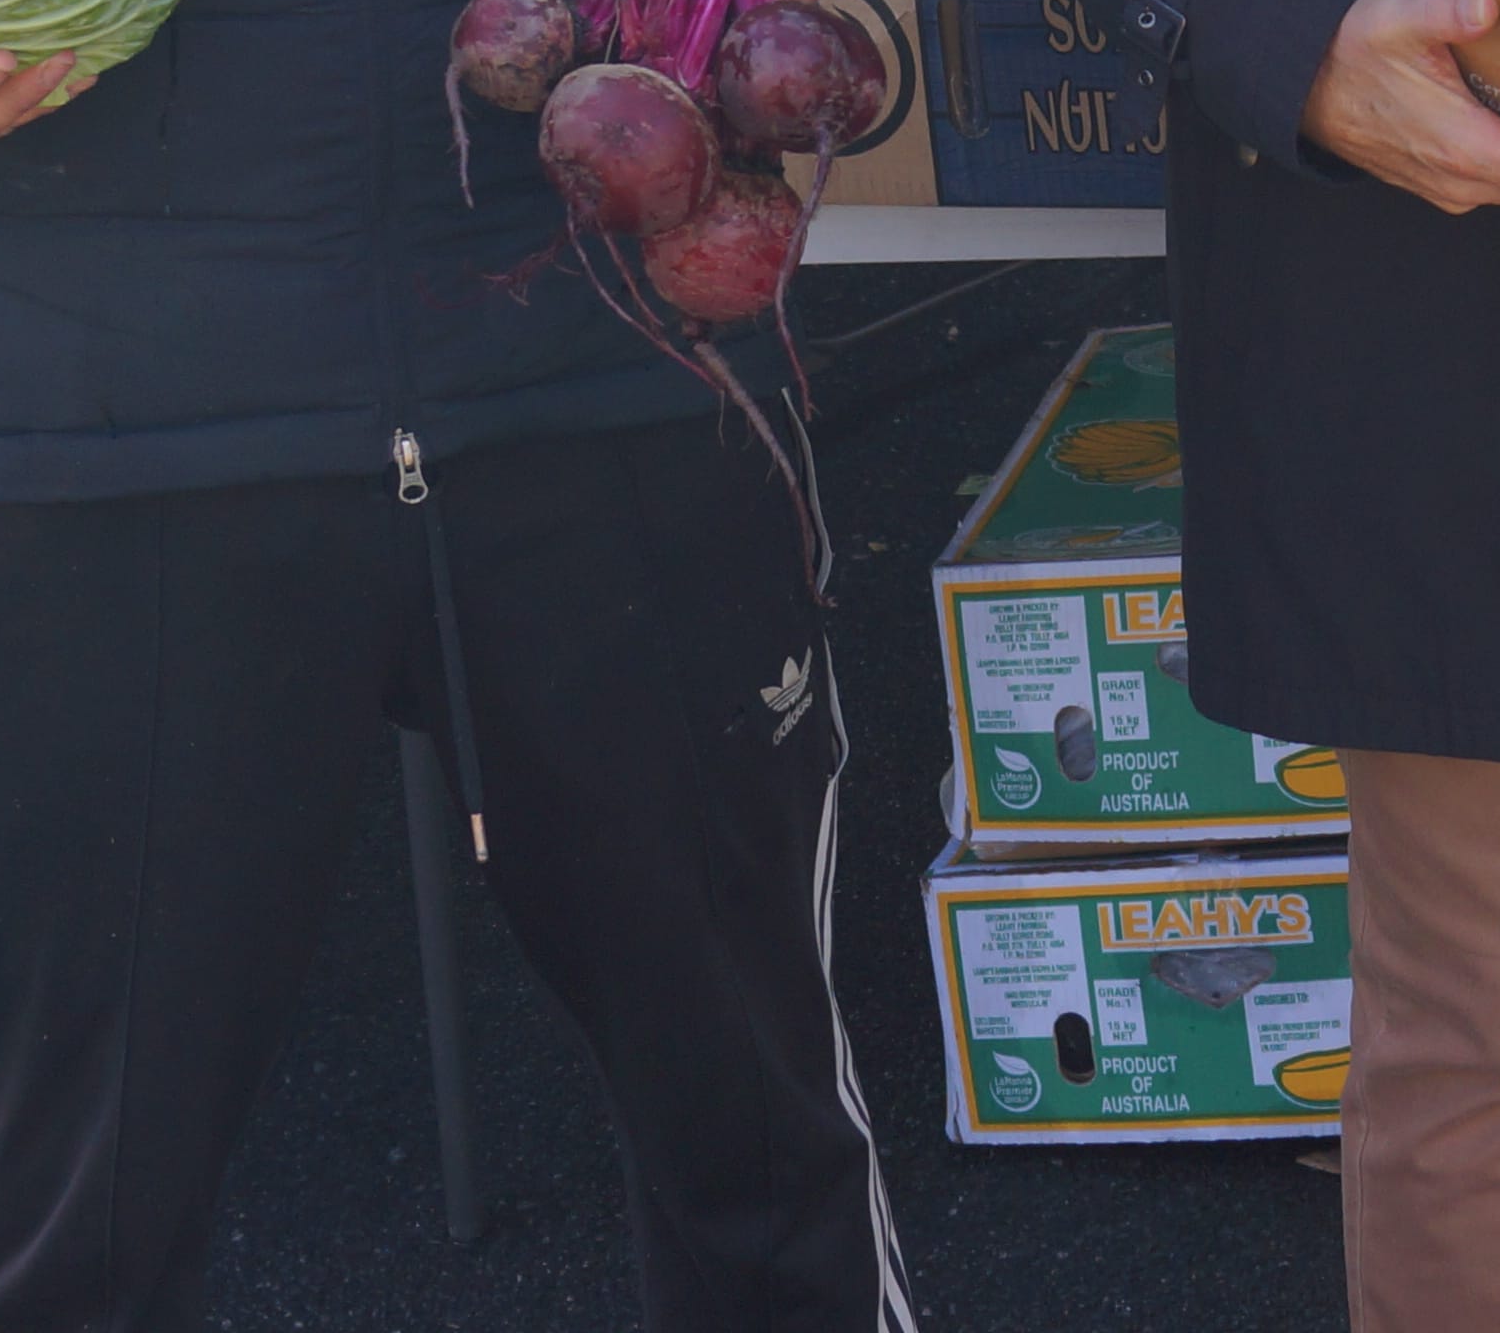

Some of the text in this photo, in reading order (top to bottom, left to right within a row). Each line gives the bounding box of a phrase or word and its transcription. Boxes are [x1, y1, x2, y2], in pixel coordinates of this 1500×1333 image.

[1101, 679, 1141, 691] GRADE
[772, 691, 813, 746] adidas
[1114, 726, 1137, 737] NET
[1101, 750, 1180, 772] PRODUCT
[1130, 772, 1154, 792] OF
[1100, 791, 1191, 813] AUSTRALIA
[1097, 893, 1315, 953] LEAHY'S
[1097, 986, 1138, 999] GRADE
[1112, 1031, 1135, 1043] NET
[1101, 1055, 1178, 1075] PRODUCT
[1130, 1075, 1153, 1094] OF
[1101, 1093, 1190, 1114] AUSTRALIA
